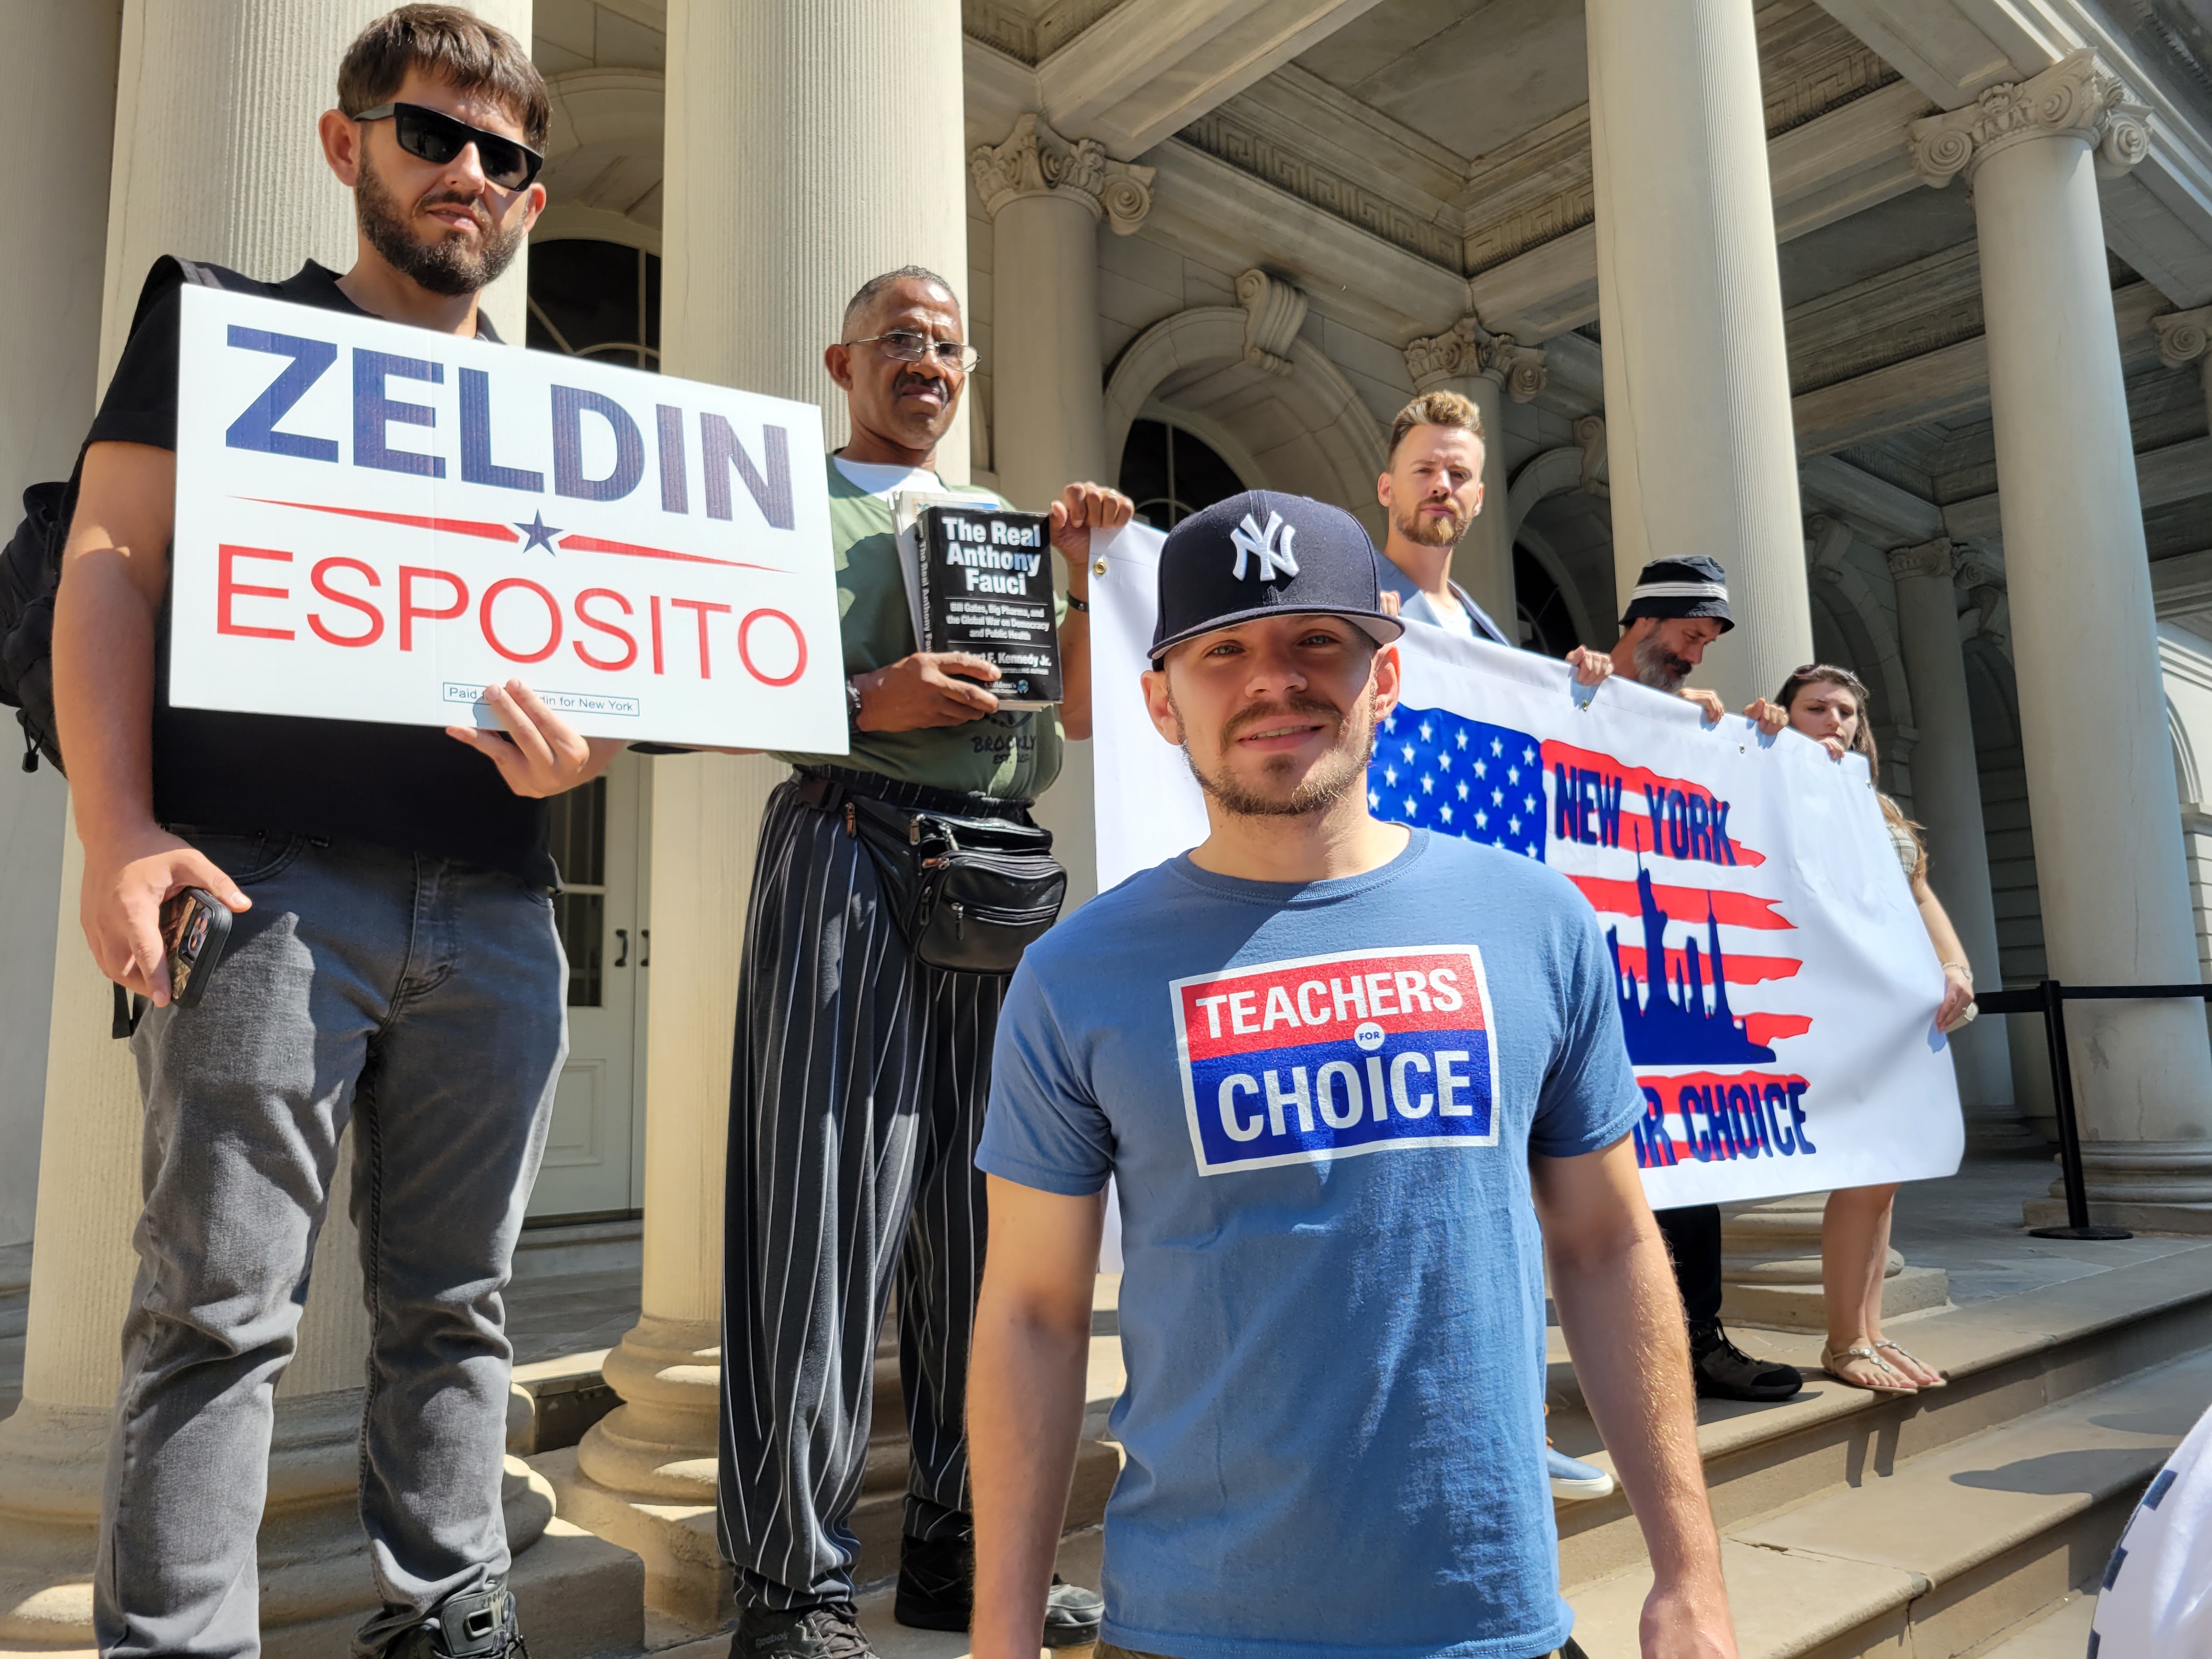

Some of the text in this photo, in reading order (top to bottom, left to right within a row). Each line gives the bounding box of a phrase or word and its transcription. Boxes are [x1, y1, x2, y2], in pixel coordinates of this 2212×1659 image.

[226, 324, 795, 531] ZELDIN
[941, 516, 1041, 547] The Real
[1230, 511, 1299, 582] NY
[946, 541, 1041, 577] Anthony
[965, 567, 1026, 595] Fauci
[217, 543, 808, 687] ESPOSITO
[946, 615, 1050, 632] the Global War on Democracy
[950, 602, 1045, 618] Bill Gates, Big Pharma, and
[969, 628, 1031, 641] and Public Health
[998, 652, 1039, 667] Kennedy
[1039, 654, 1052, 667] Jr.
[450, 687, 477, 699] Paid
[560, 696, 575, 707] for
[579, 698, 605, 709] New
[608, 700, 633, 712] York
[1554, 762, 1737, 867] NEW YORK
[1195, 968, 1463, 1039] TEACHERS
[1359, 1031, 1380, 1041] FOR
[1218, 1050, 1473, 1142] CHOICE
[1679, 1082, 1816, 1163] CHOICE
